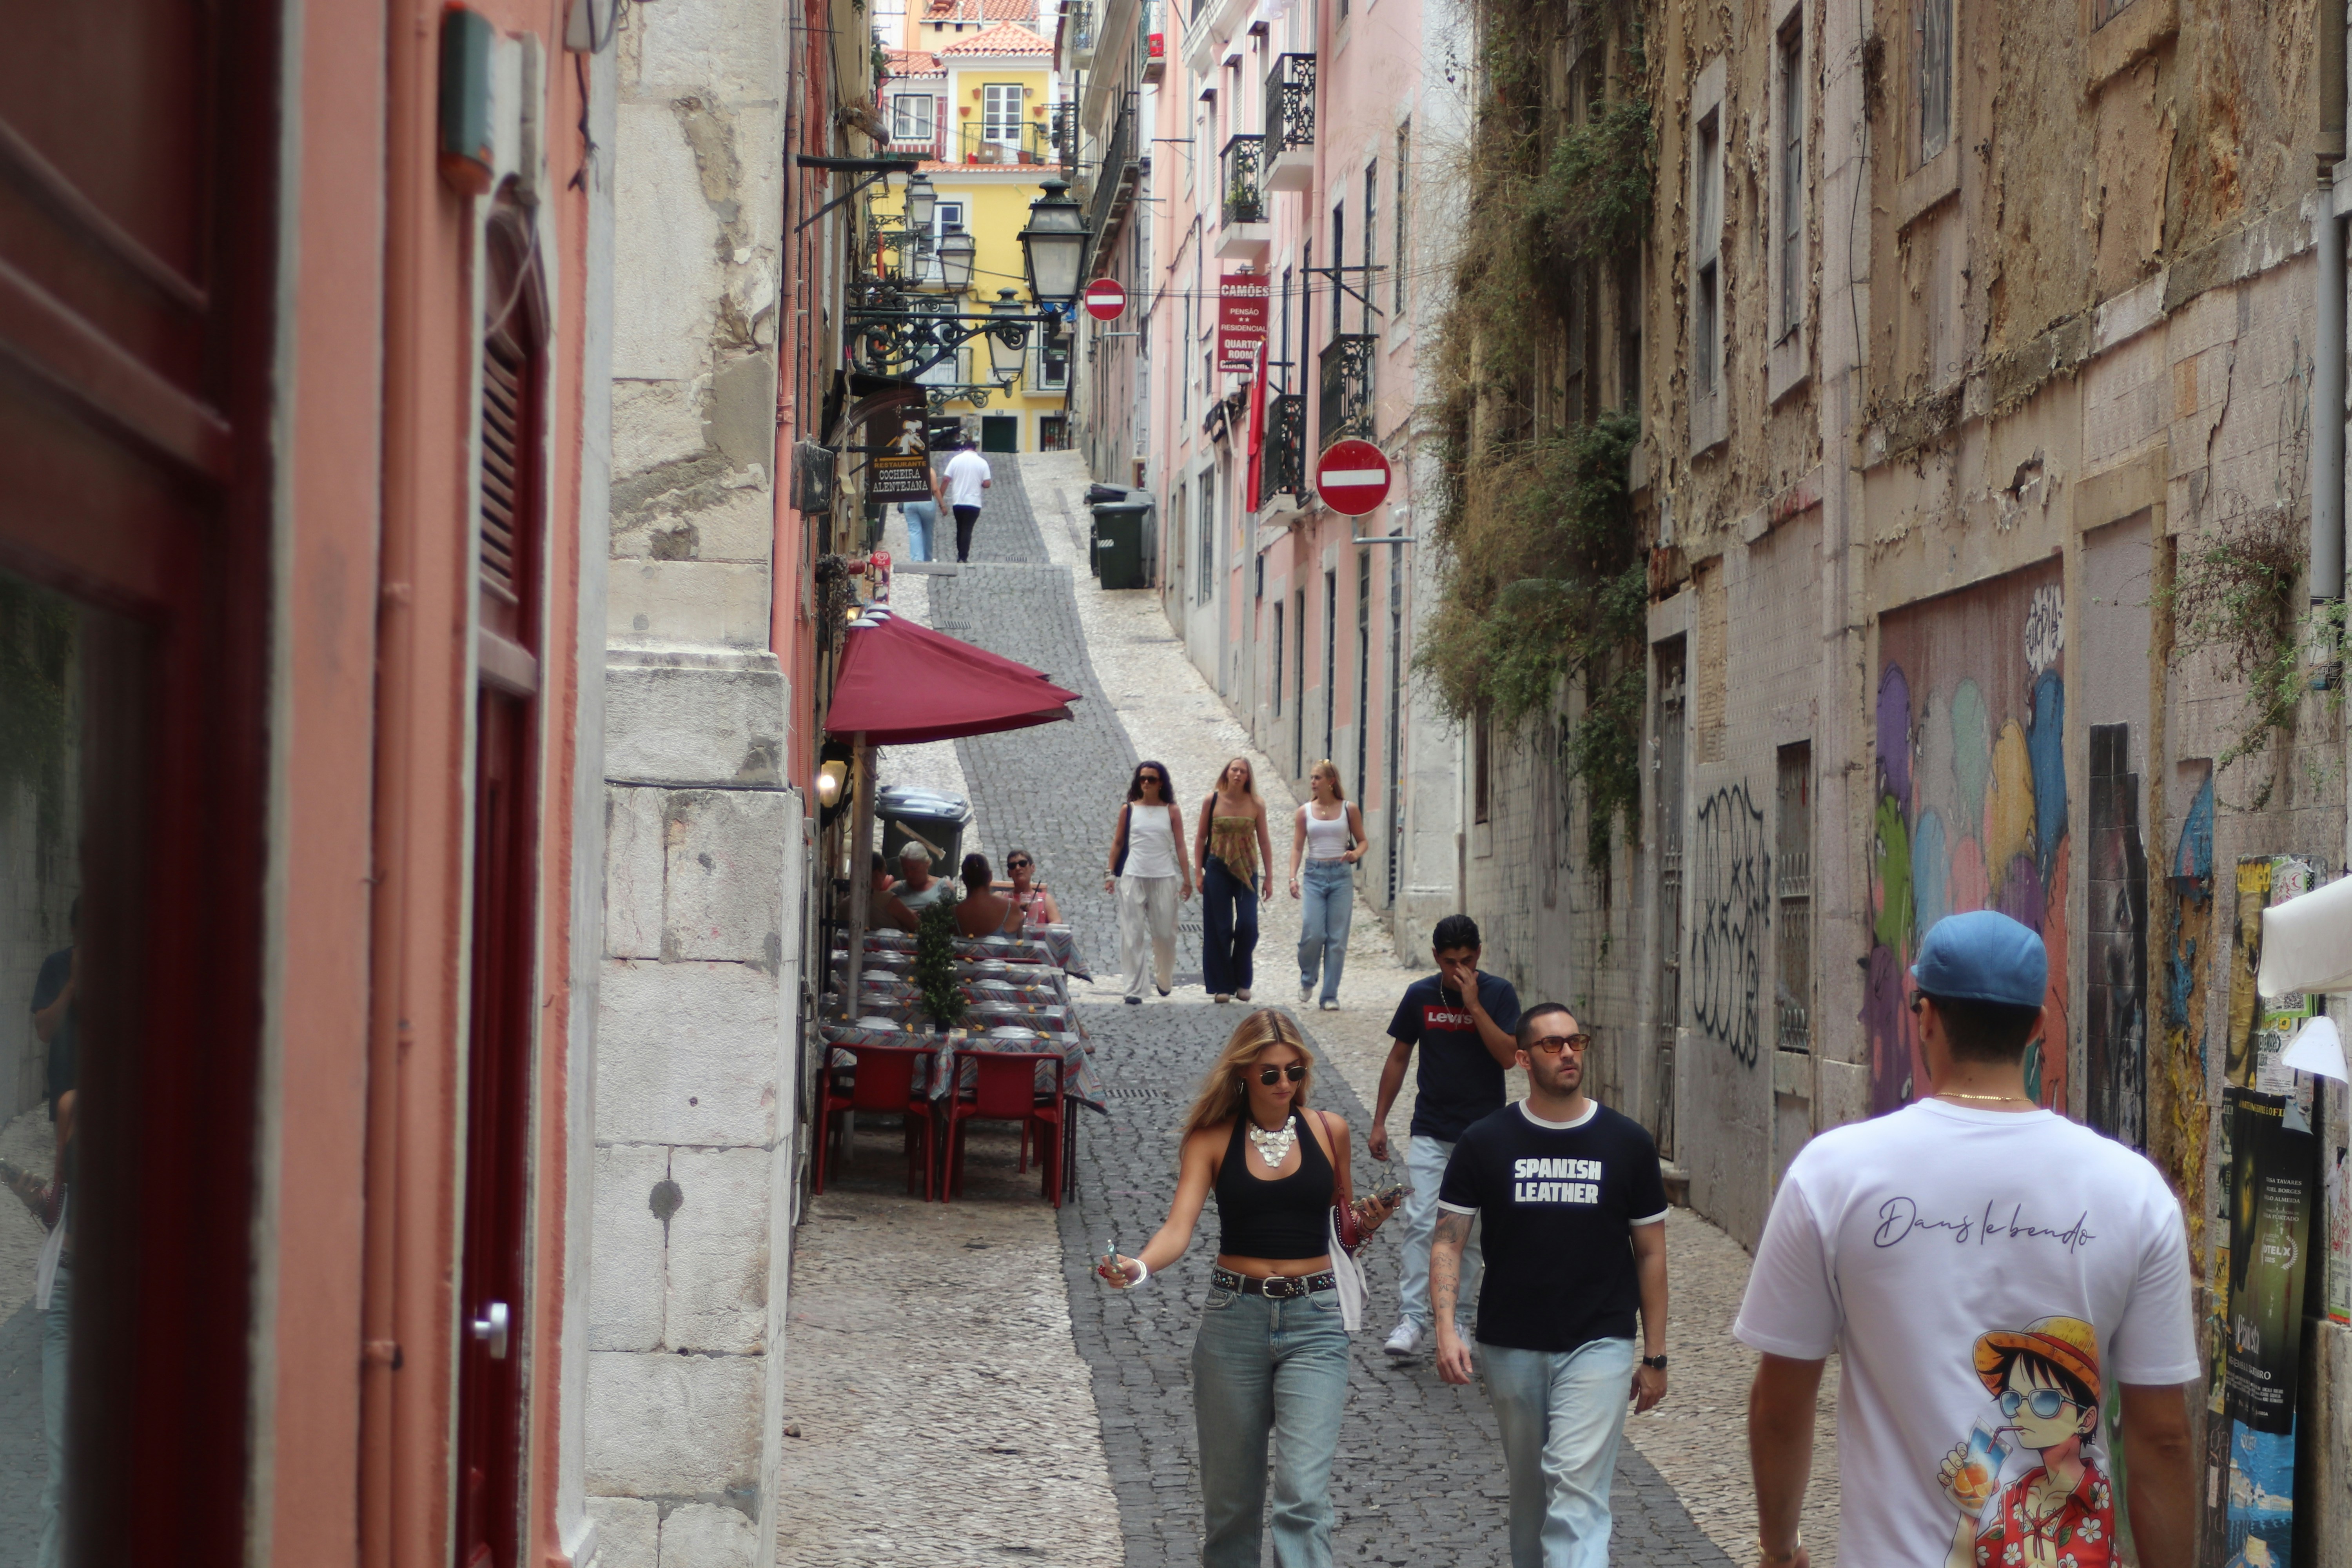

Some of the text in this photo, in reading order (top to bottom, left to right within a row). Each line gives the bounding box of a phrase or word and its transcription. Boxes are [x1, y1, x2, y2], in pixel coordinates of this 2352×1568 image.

[1221, 283, 1269, 297] CAMÕES
[1225, 339, 1259, 349] QUARTO
[1228, 350, 1253, 359] ROOM
[879, 468, 921, 480] COCHEIRA
[873, 480, 929, 492] ALENTEJANA
[1515, 1158, 1602, 1180] SPANISH
[1515, 1182, 1599, 1204] LEATHER
[1874, 1196, 1974, 1248] Dans
